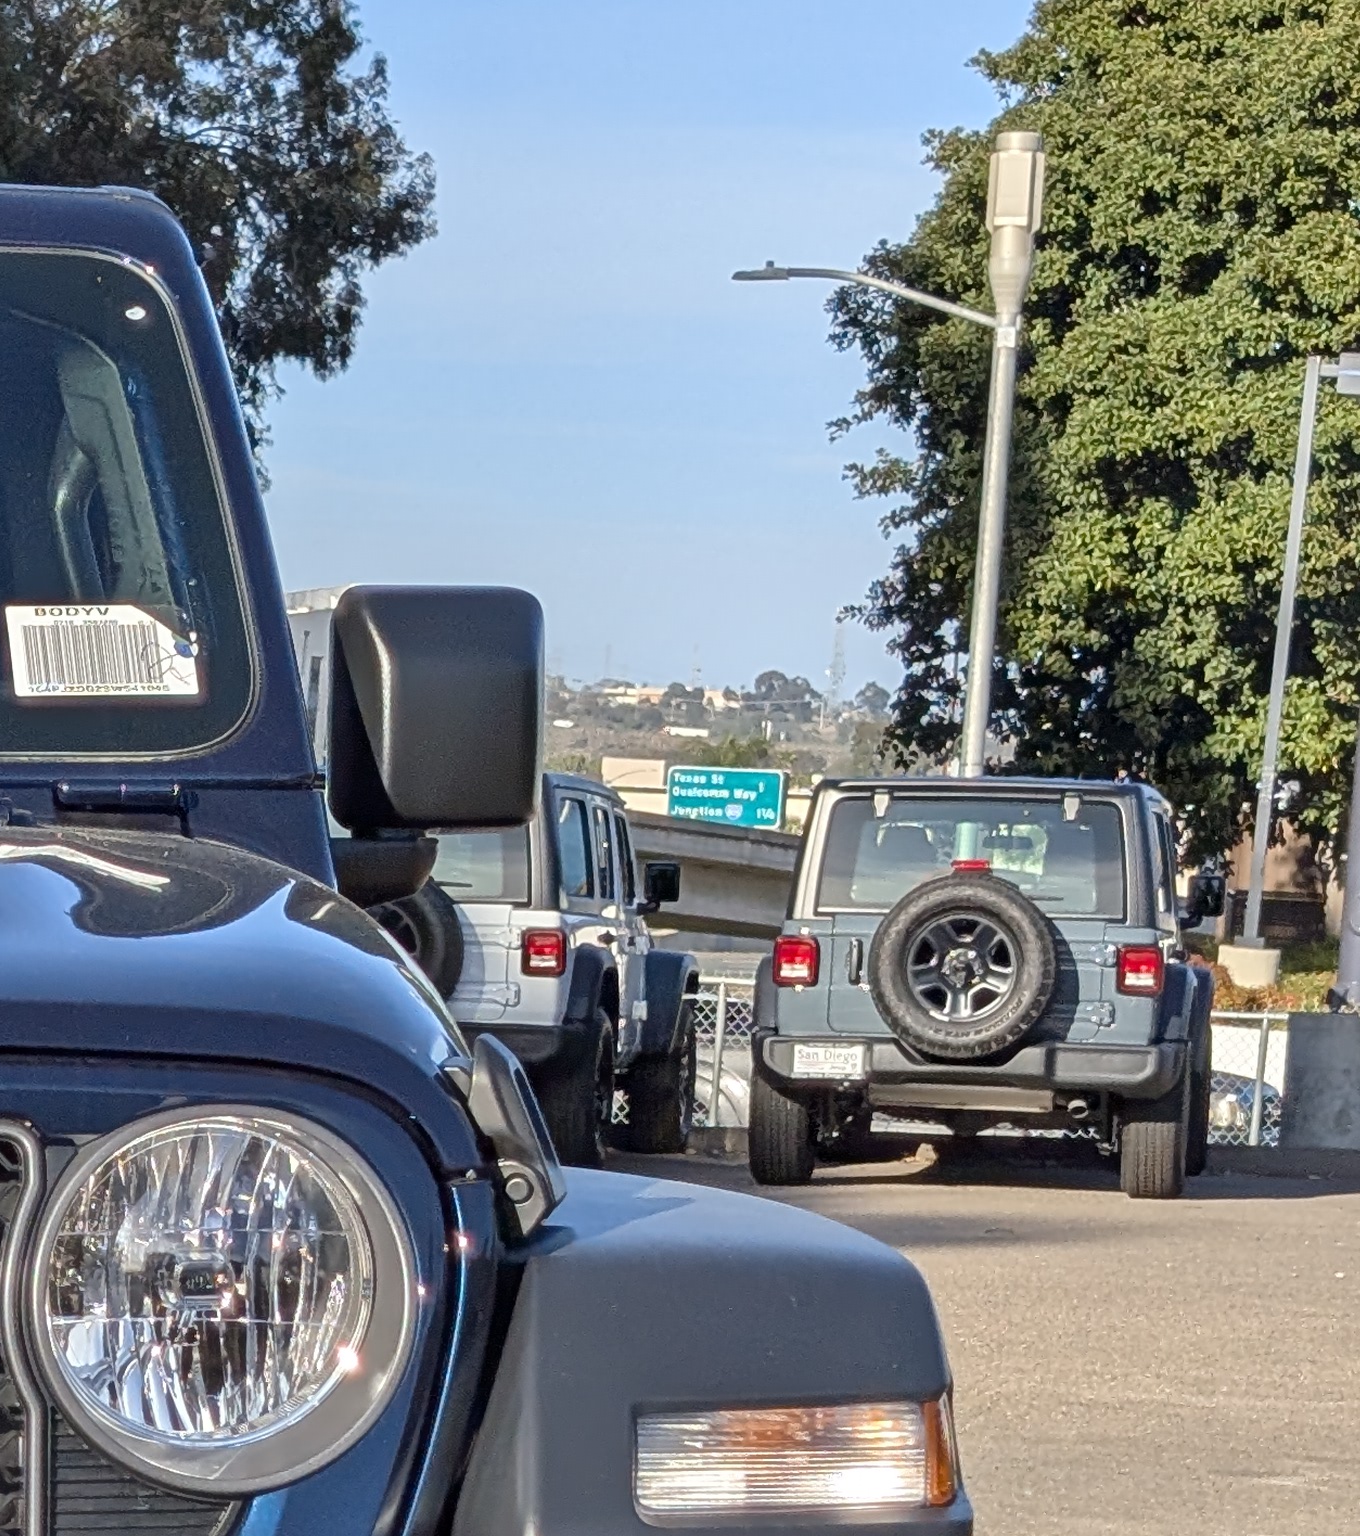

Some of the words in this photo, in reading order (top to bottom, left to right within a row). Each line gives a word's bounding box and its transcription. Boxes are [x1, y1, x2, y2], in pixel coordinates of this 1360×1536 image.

[34, 607, 109, 617] BODYV
[674, 773, 707, 784] Texas
[711, 774, 725, 785] St
[672, 786, 730, 799] Qualcomm
[733, 788, 757, 801] Way
[670, 805, 723, 818] Junction
[798, 1048, 819, 1061] San
[824, 1049, 857, 1064] Diego
